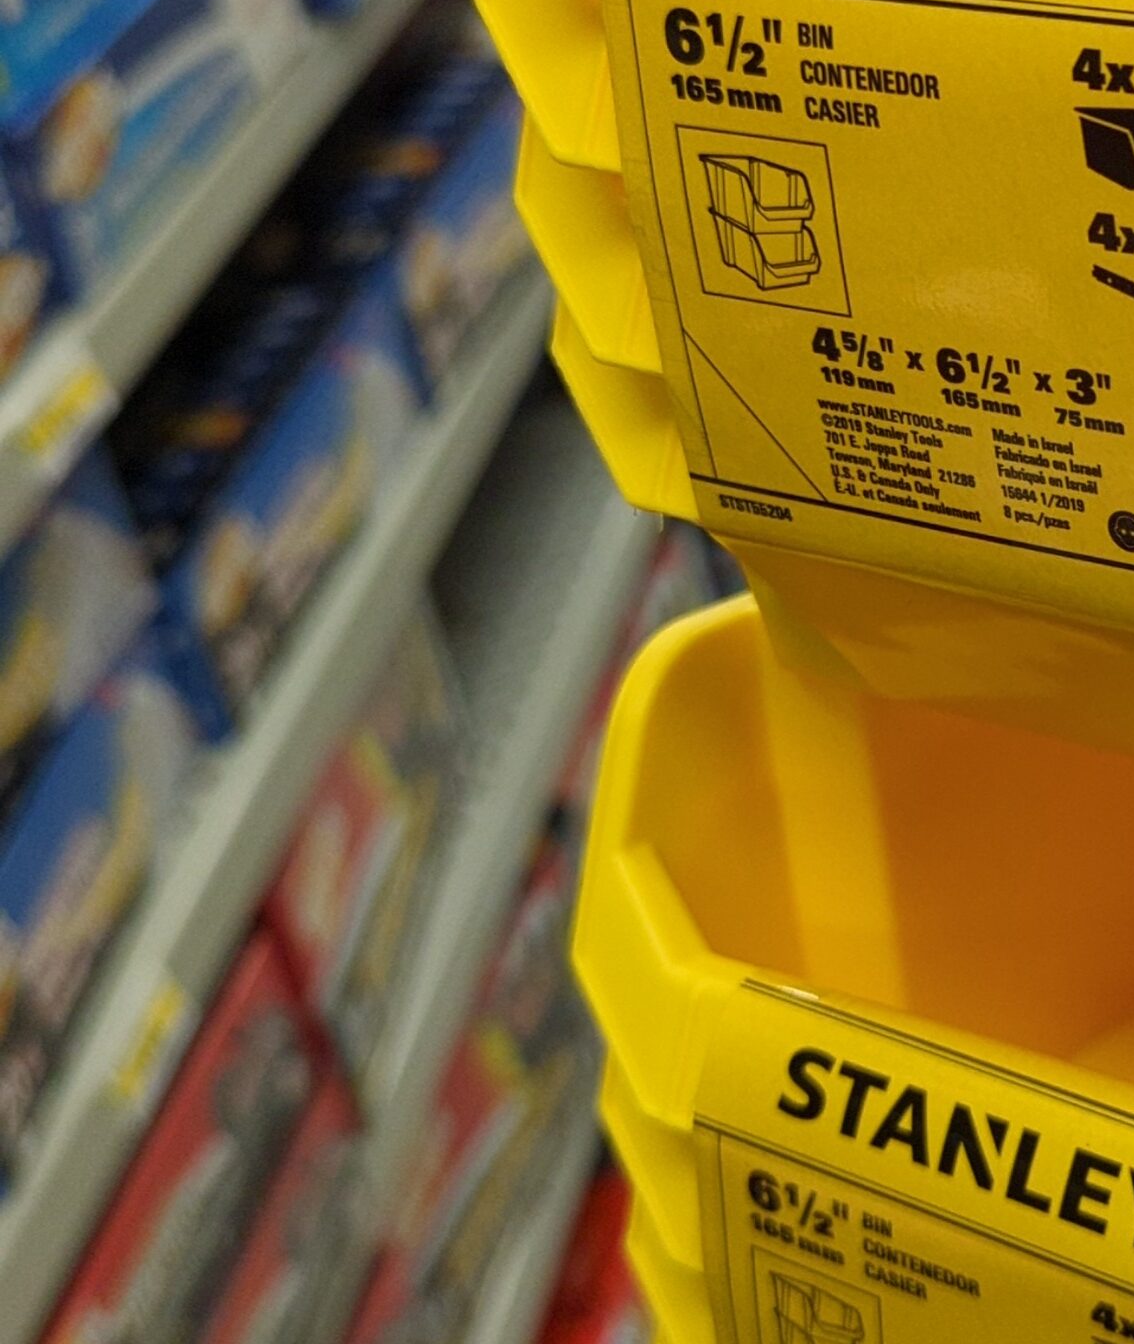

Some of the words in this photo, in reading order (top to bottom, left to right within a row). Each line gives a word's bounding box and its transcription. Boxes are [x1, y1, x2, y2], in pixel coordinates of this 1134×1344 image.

[798, 22, 834, 50] BIN
[800, 59, 941, 99] CONTENEDOR
[804, 96, 880, 128] CASIER
[905, 350, 925, 371] x
[1033, 371, 1054, 394] x
[817, 399, 973, 437] www.STANLEYTOOLS.com
[824, 430, 846, 447] 701
[864, 438, 898, 457] Joppa
[900, 445, 931, 463] Road
[865, 422, 909, 445] Stanley
[910, 430, 943, 449] Tools
[992, 428, 1026, 447] Made
[1028, 434, 1039, 449] in
[1041, 436, 1075, 456] Israel
[826, 447, 876, 469] Towson,
[877, 457, 932, 480] Maryland
[994, 445, 1050, 468] Fabricado
[1052, 459, 1067, 472] en
[1070, 459, 1102, 478] Israel
[997, 463, 1046, 486] Fabriqué
[1049, 477, 1063, 488] en
[830, 464, 854, 481] U.S.
[857, 469, 867, 482] &
[869, 472, 912, 492] Canada
[914, 481, 940, 499] Only
[863, 488, 875, 500] et
[877, 489, 919, 509] Canada
[922, 501, 982, 523] seulement
[862, 1211, 893, 1238] BIN
[863, 1237, 981, 1297] CONTENEDOR
[864, 1261, 927, 1300] CASIER
